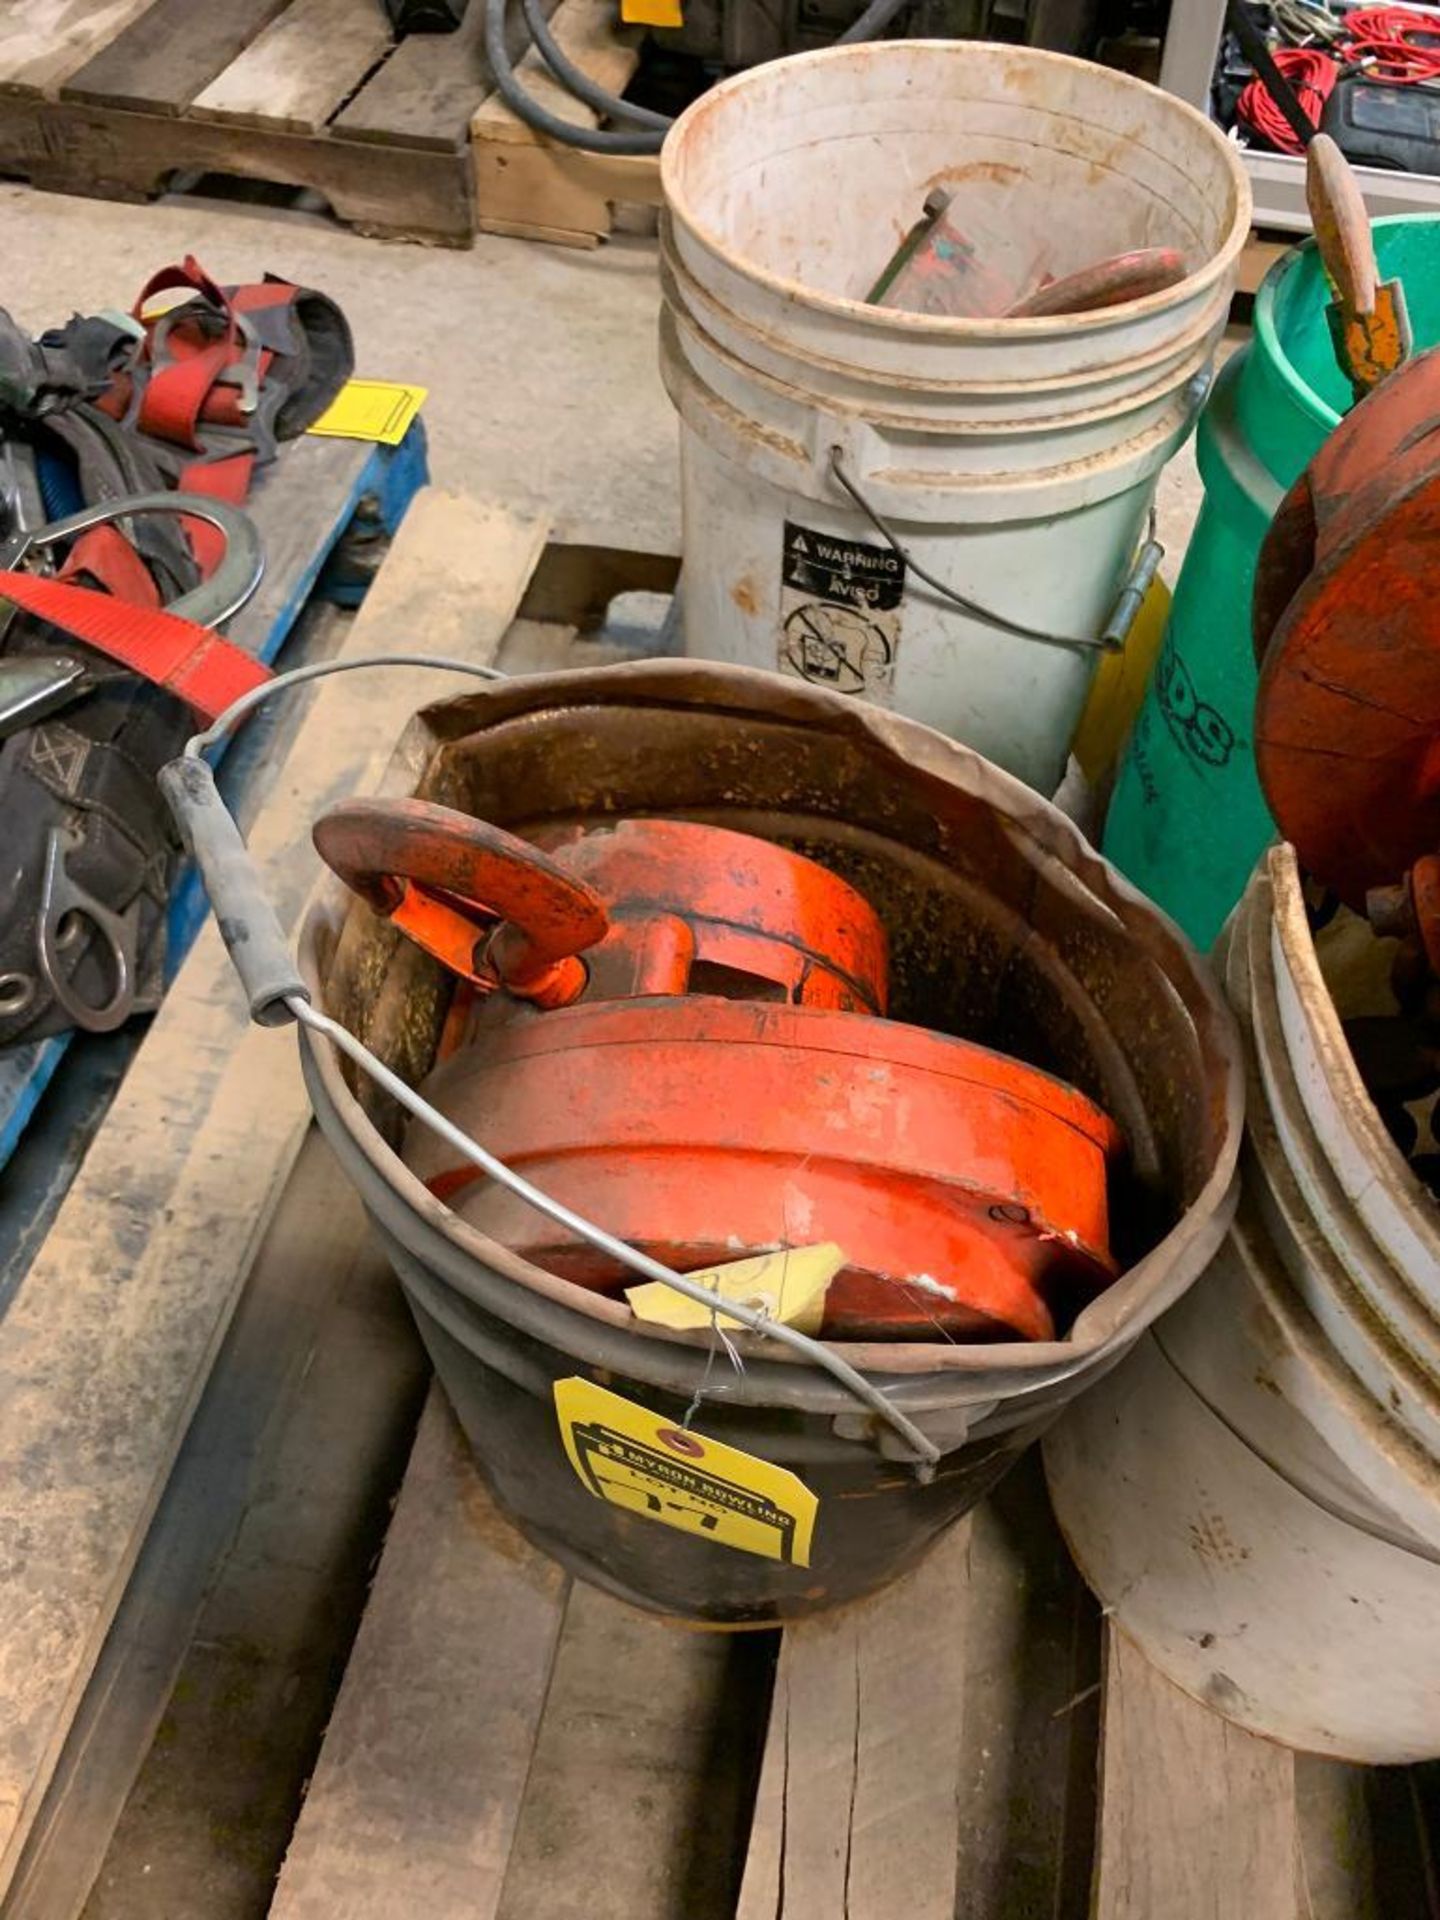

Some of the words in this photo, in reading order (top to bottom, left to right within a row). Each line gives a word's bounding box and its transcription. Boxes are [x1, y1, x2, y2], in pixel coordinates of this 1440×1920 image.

[818, 545, 898, 572] WARNING
[829, 580, 880, 600] AVISO
[628, 1451, 696, 1487] MYRON
[702, 1483, 791, 1527] BOWLING
